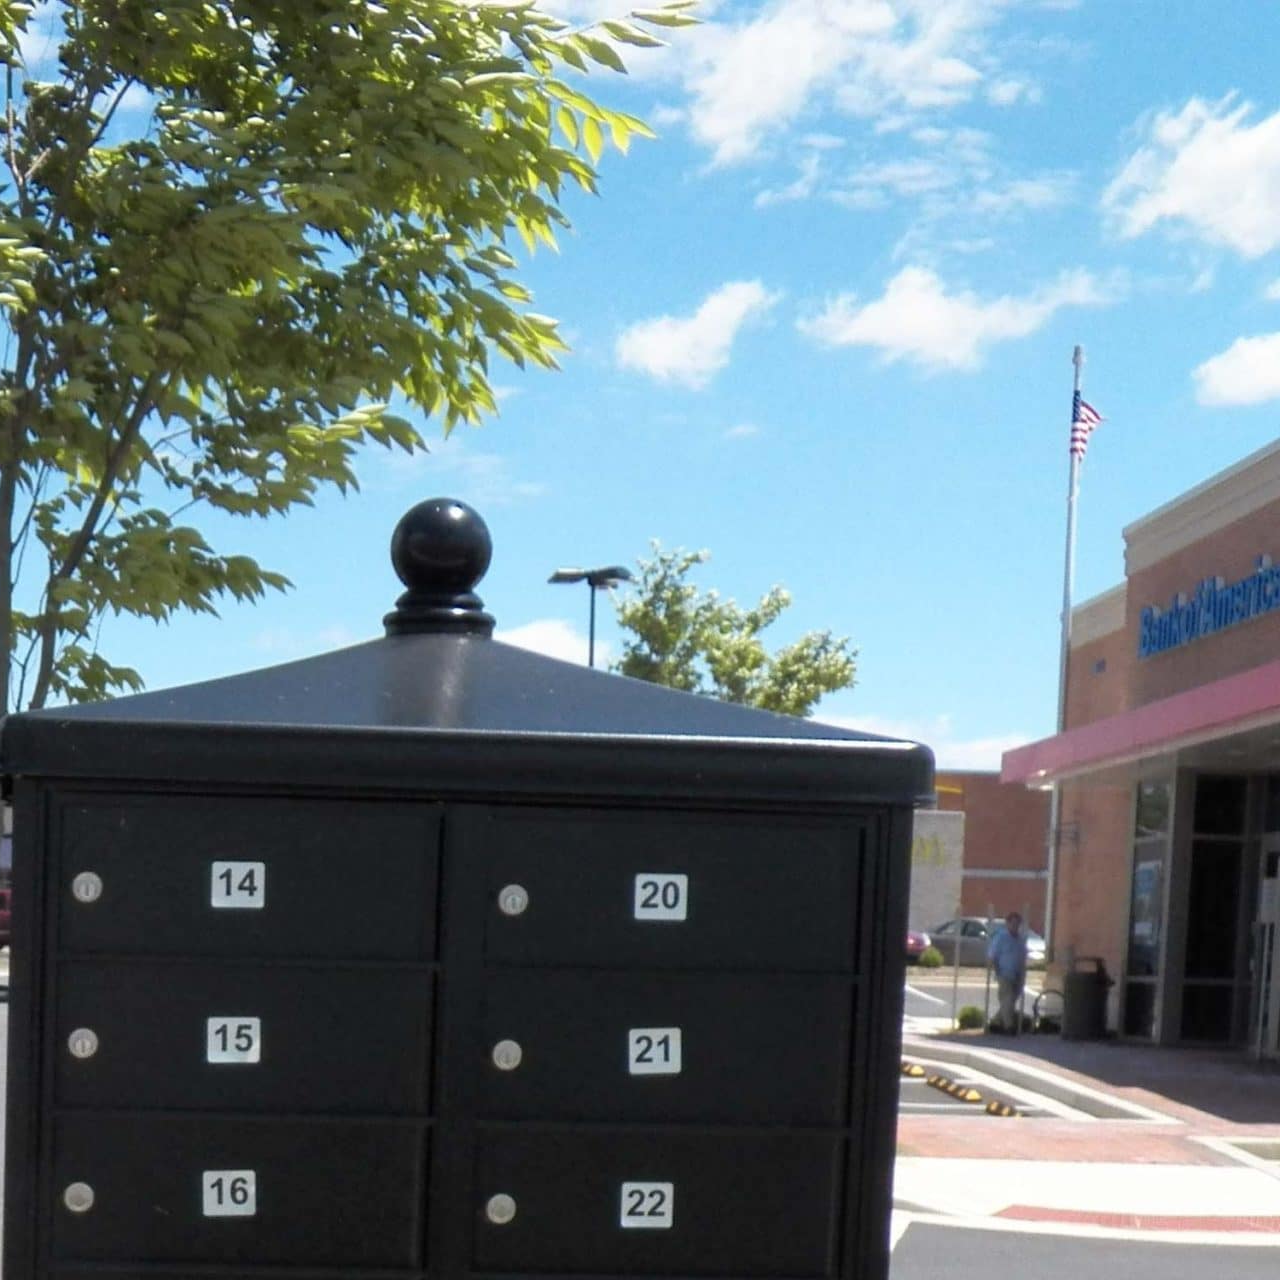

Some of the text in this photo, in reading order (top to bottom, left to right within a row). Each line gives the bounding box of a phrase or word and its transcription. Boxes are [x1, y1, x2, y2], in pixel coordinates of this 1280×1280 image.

[218, 867, 259, 898] 14
[639, 880, 681, 910] 20
[214, 1023, 254, 1053] 15
[634, 1033, 671, 1064] 21
[209, 1176, 249, 1206] 16
[626, 1188, 667, 1218] 22
